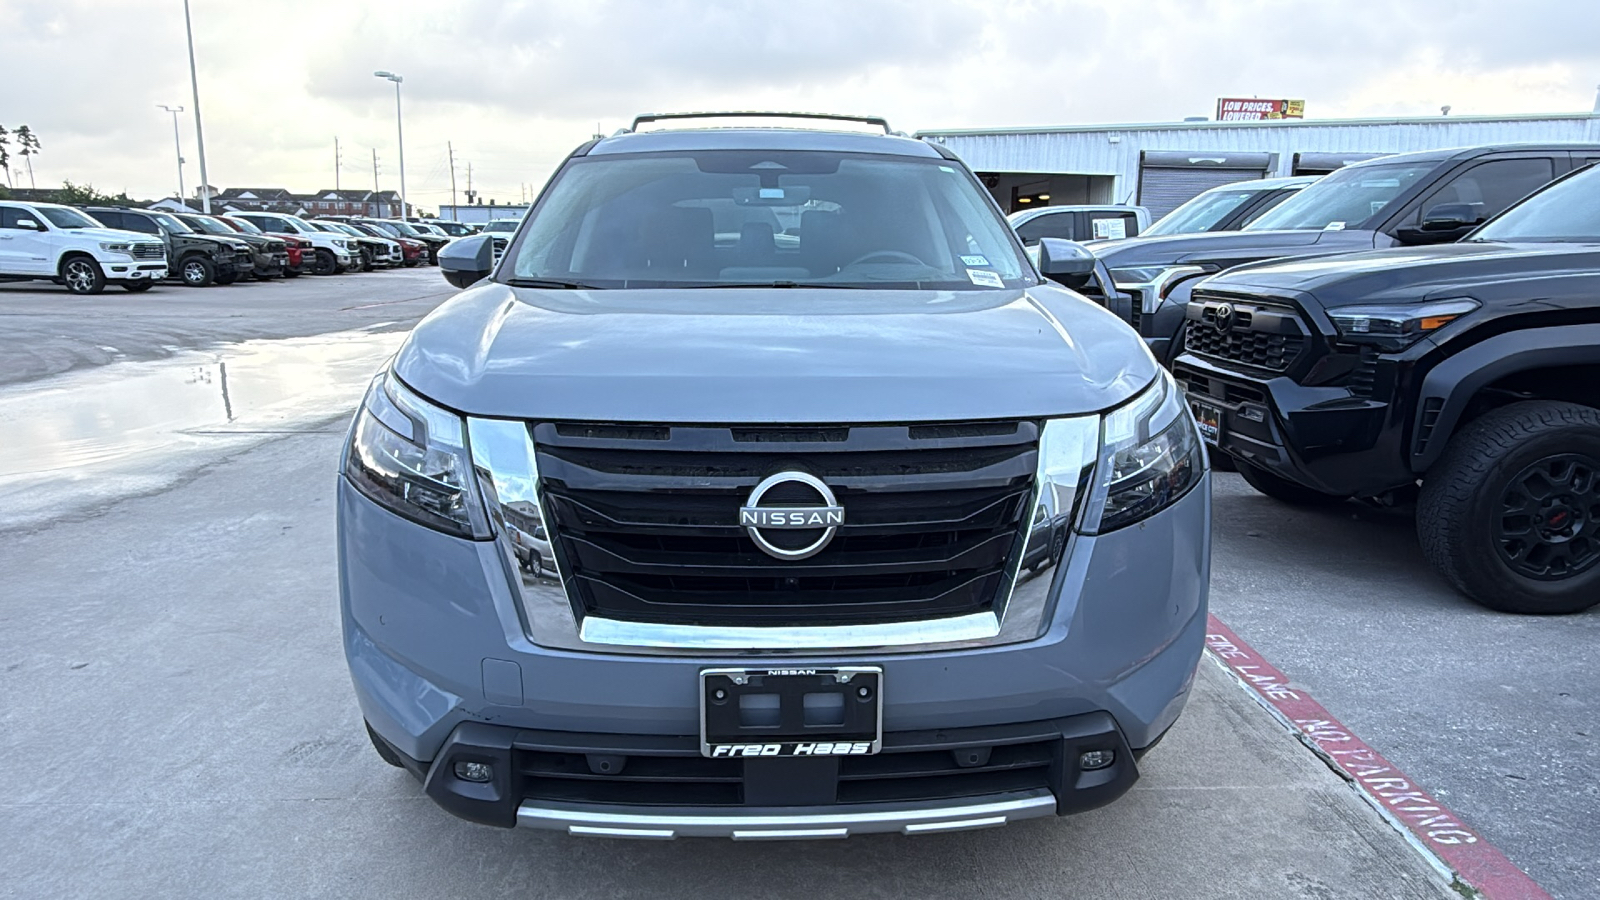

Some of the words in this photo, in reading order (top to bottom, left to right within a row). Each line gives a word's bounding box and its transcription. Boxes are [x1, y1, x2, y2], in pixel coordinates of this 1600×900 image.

[1223, 101, 1242, 111] LOW
[1242, 102, 1274, 112] PRICES,
[1223, 112, 1262, 121] LOWERED
[742, 510, 842, 525] NISSAN
[1205, 634, 1250, 659] FIRE
[1235, 665, 1300, 700] LANE
[1294, 719, 1351, 742] NO
[1331, 749, 1477, 844] PARKING
[793, 742, 871, 755] Haas
